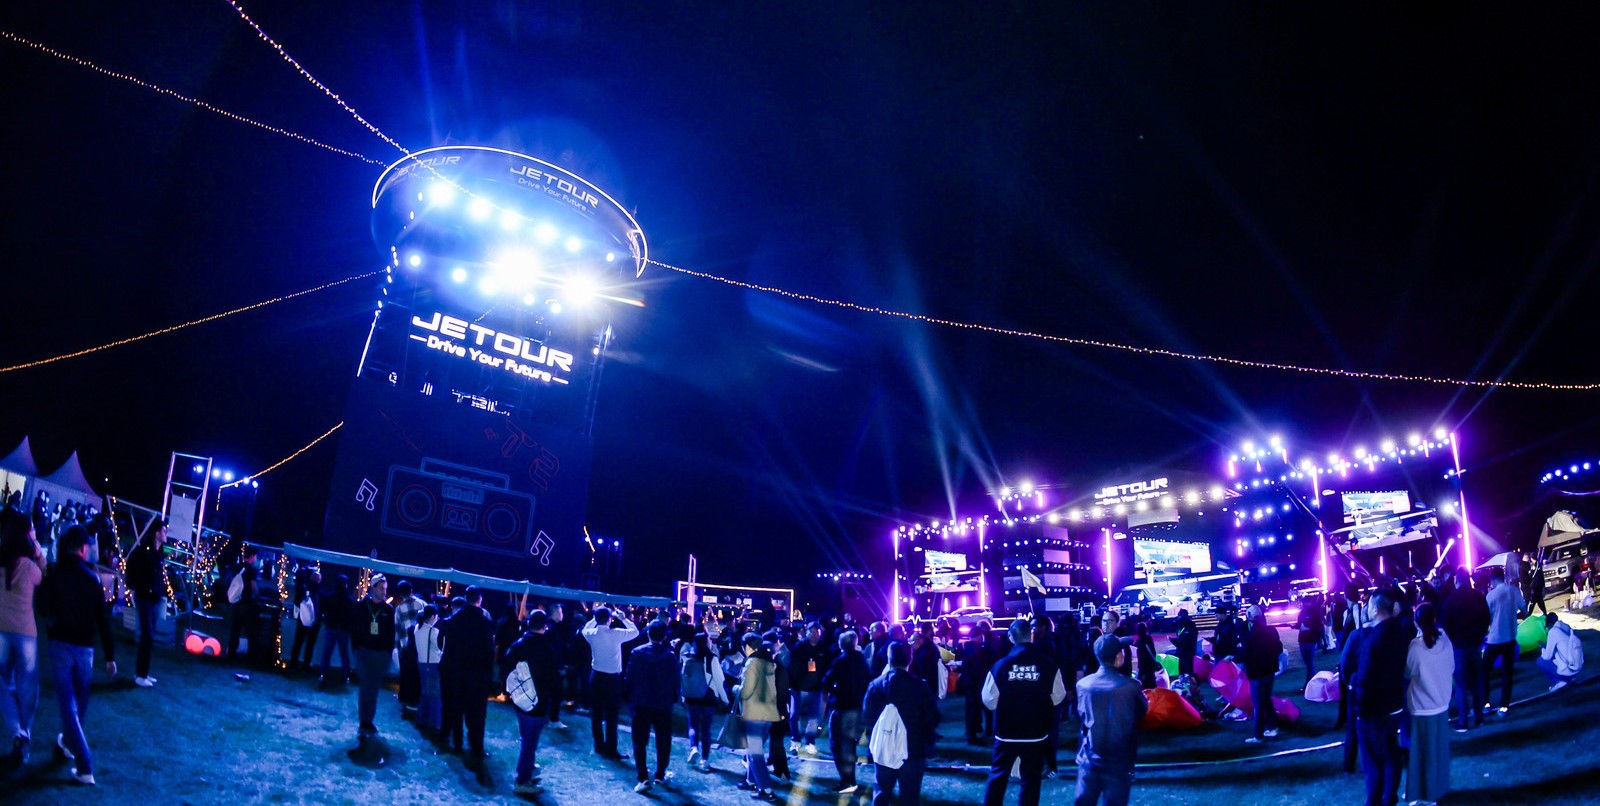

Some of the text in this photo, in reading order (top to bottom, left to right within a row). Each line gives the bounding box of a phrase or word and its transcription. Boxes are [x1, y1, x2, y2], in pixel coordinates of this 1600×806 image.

[510, 166, 599, 208] JETOUR
[518, 177, 587, 211] Drive Your Future
[412, 312, 573, 372] JETOUR
[427, 334, 552, 382] Drive Your Future
[1094, 478, 1168, 499] JETOUR
[1008, 671, 1040, 681] Bear
